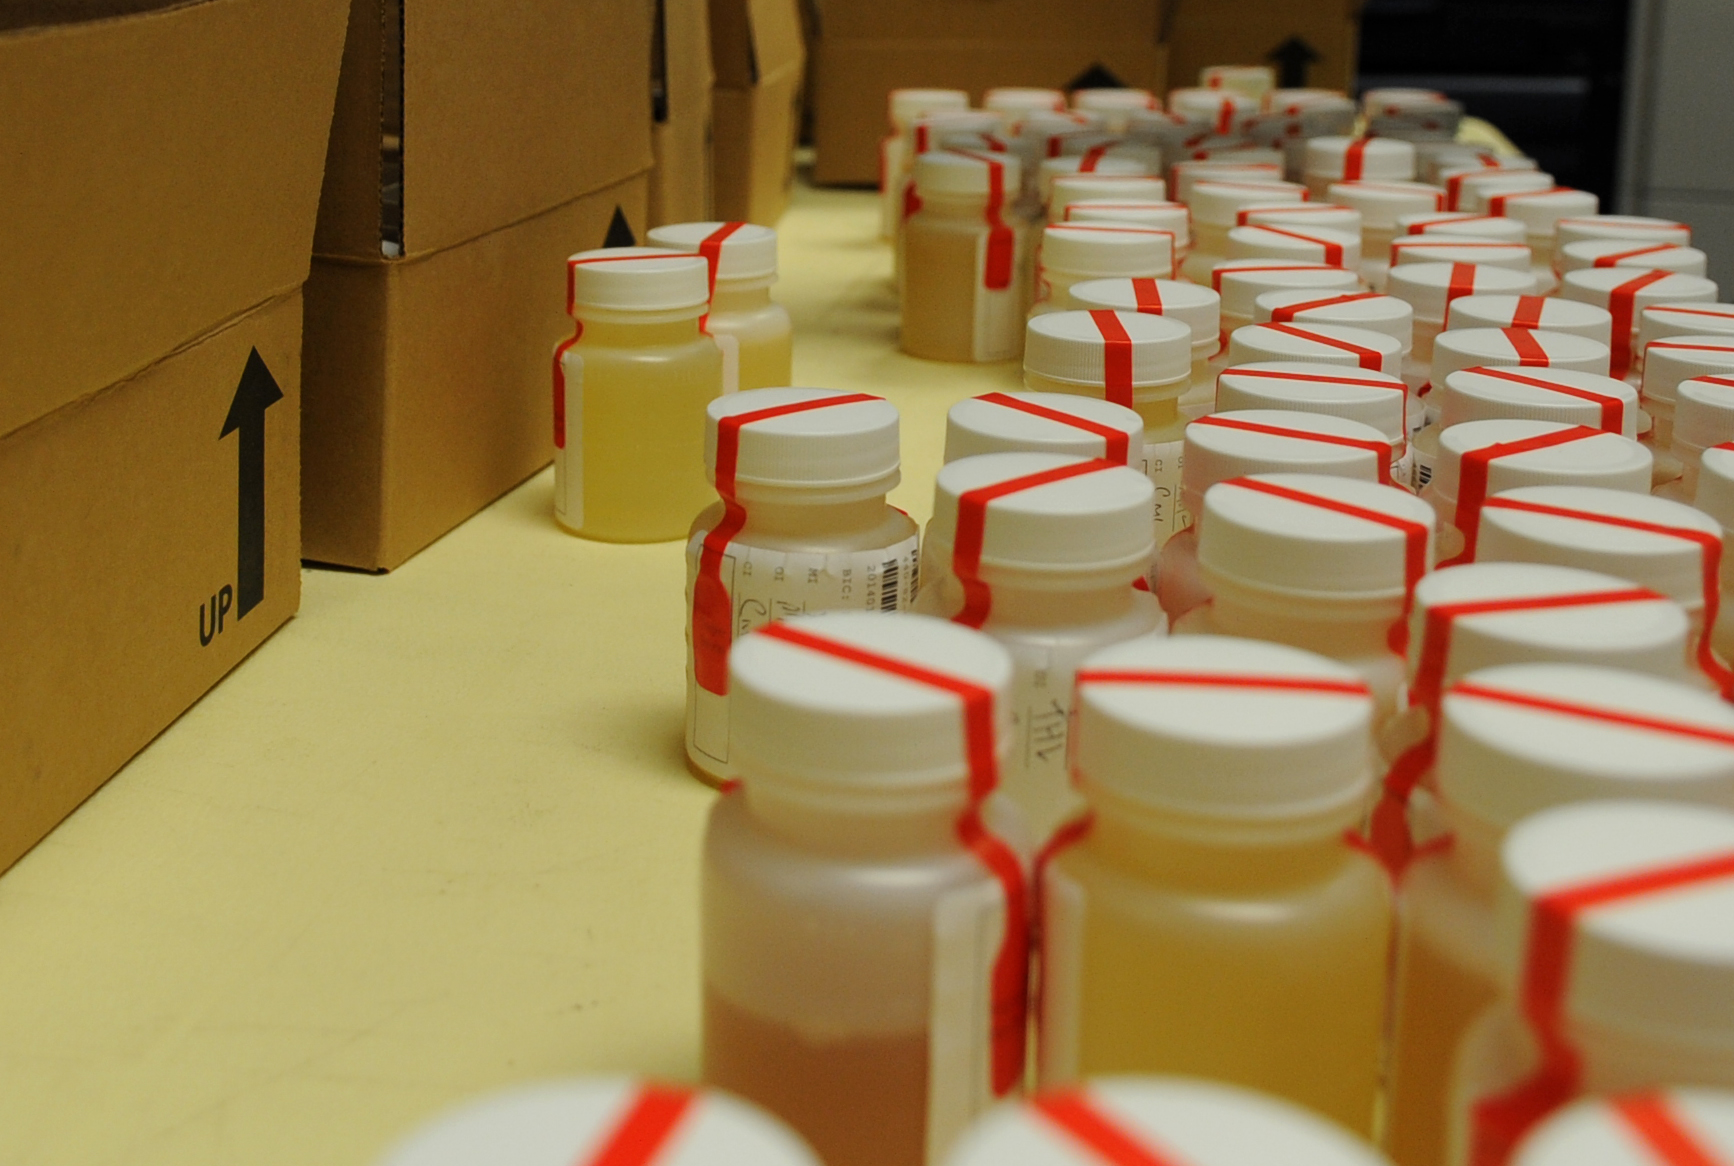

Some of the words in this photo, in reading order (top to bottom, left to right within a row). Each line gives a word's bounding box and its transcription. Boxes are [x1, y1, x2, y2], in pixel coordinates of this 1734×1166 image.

[1154, 459, 1163, 472] CI
[742, 561, 752, 576] CI
[807, 567, 819, 584] MI
[841, 568, 852, 600] BIC:
[199, 583, 233, 647] UP
